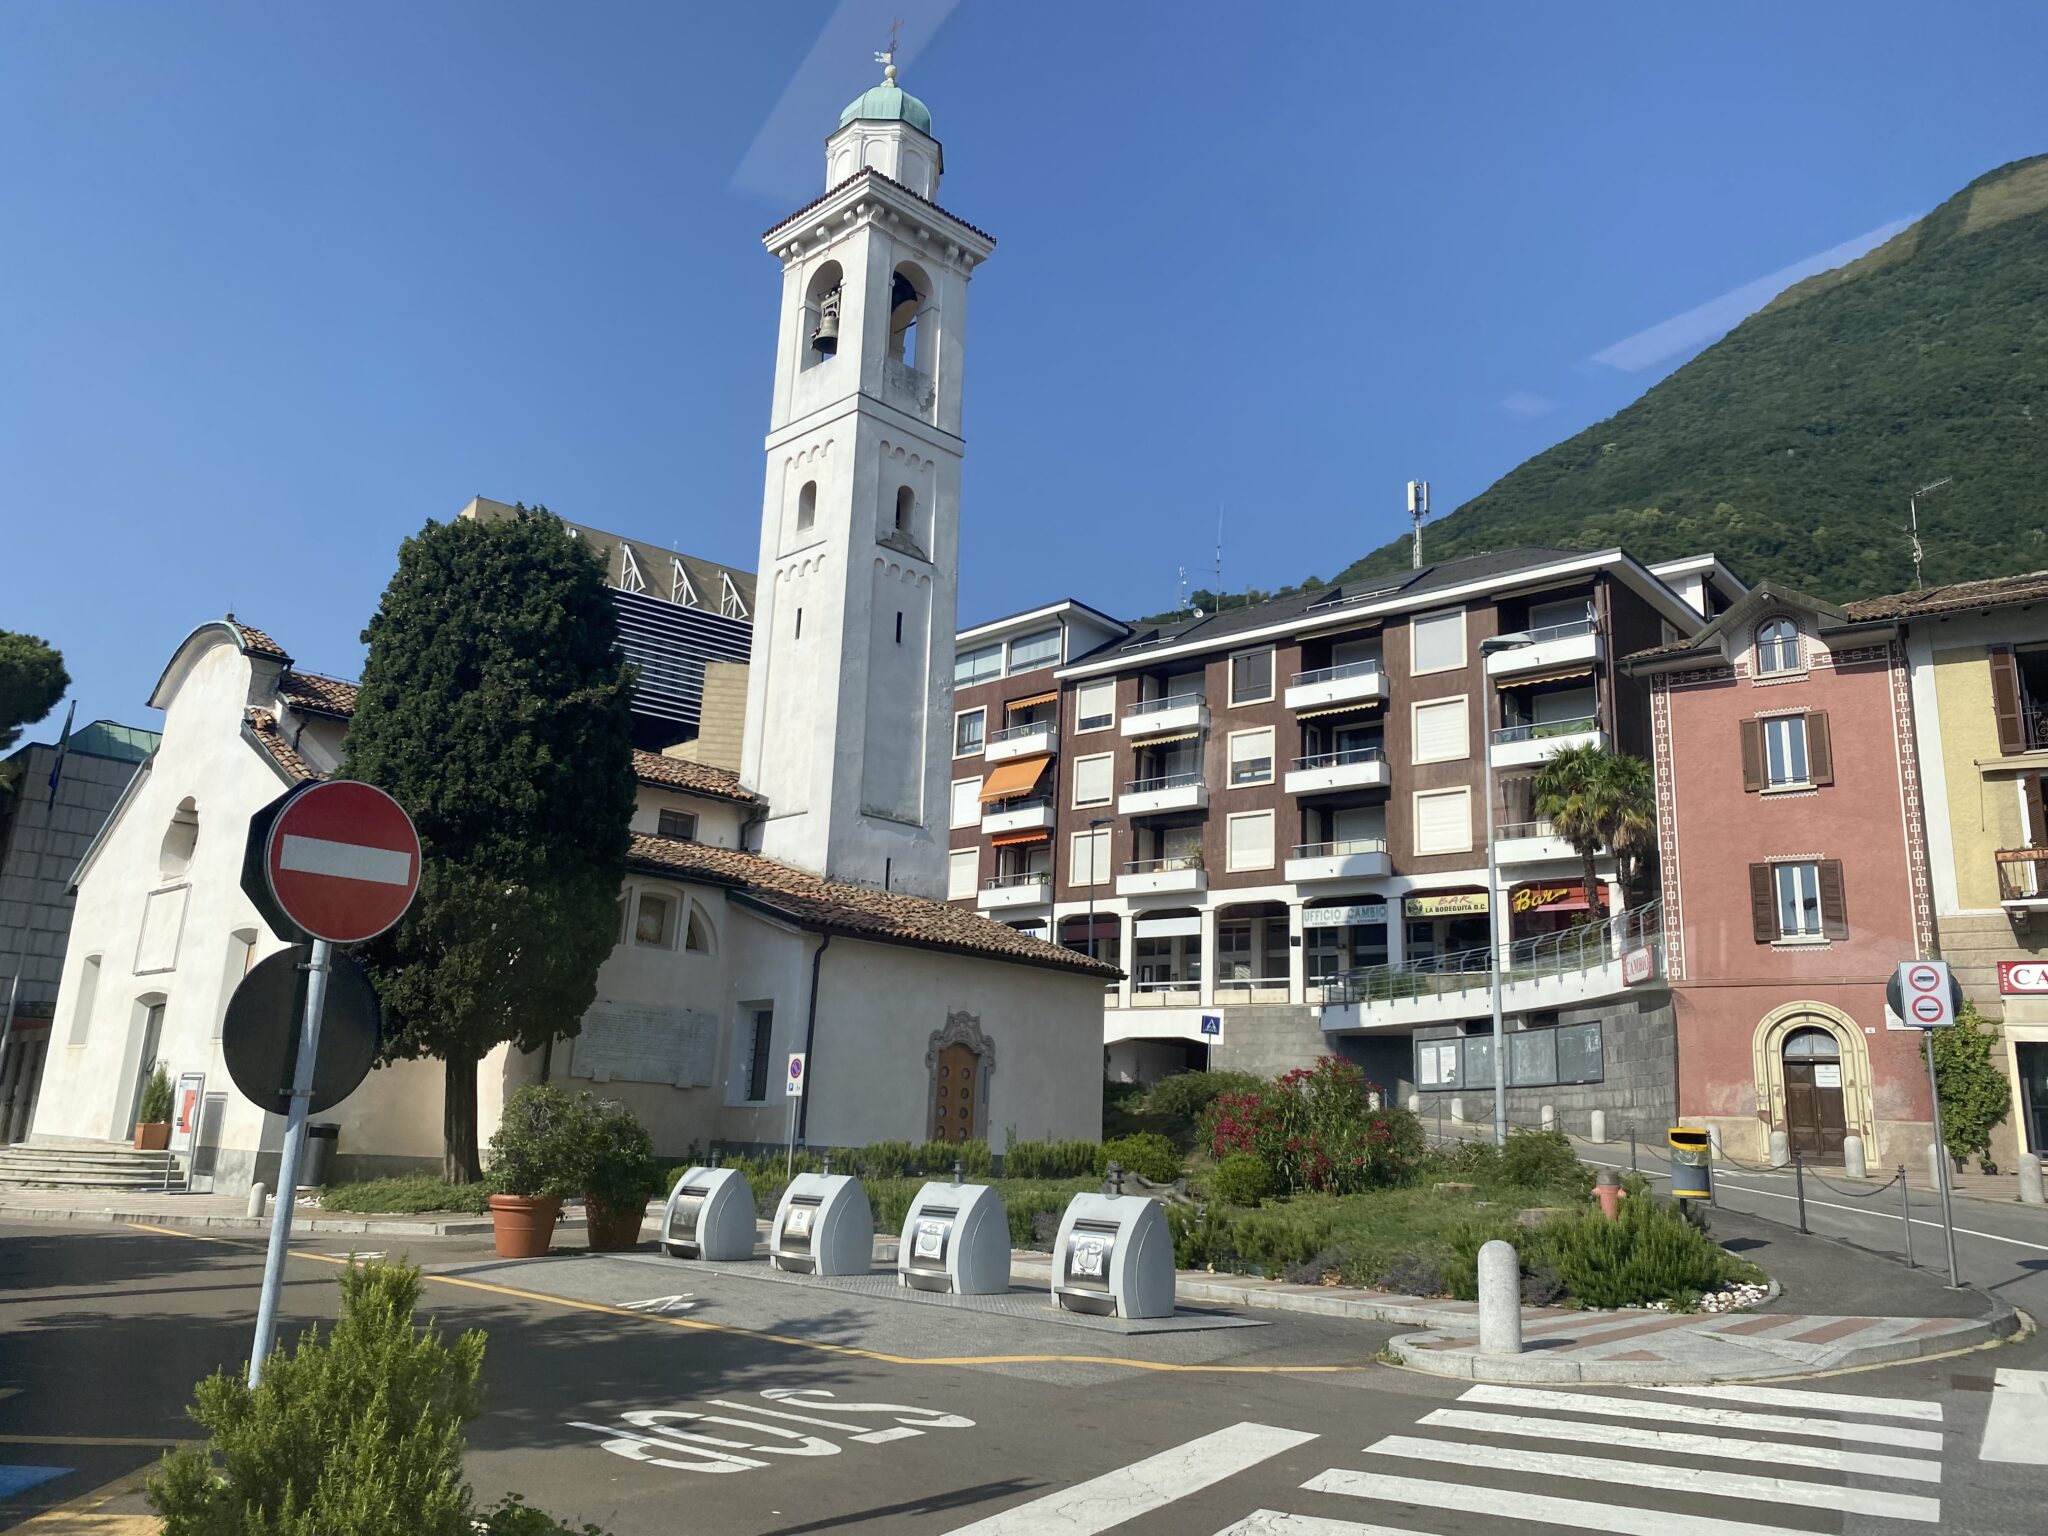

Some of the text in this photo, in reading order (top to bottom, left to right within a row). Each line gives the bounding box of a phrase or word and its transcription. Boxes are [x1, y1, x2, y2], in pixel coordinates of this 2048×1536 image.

[1439, 896, 1472, 905] BAR
[1514, 888, 1568, 912] Bar
[1304, 906, 1386, 921] UFFICIO CAMBIO
[1435, 905, 1472, 913] BODEGUITA
[566, 1388, 977, 1474] STOP
